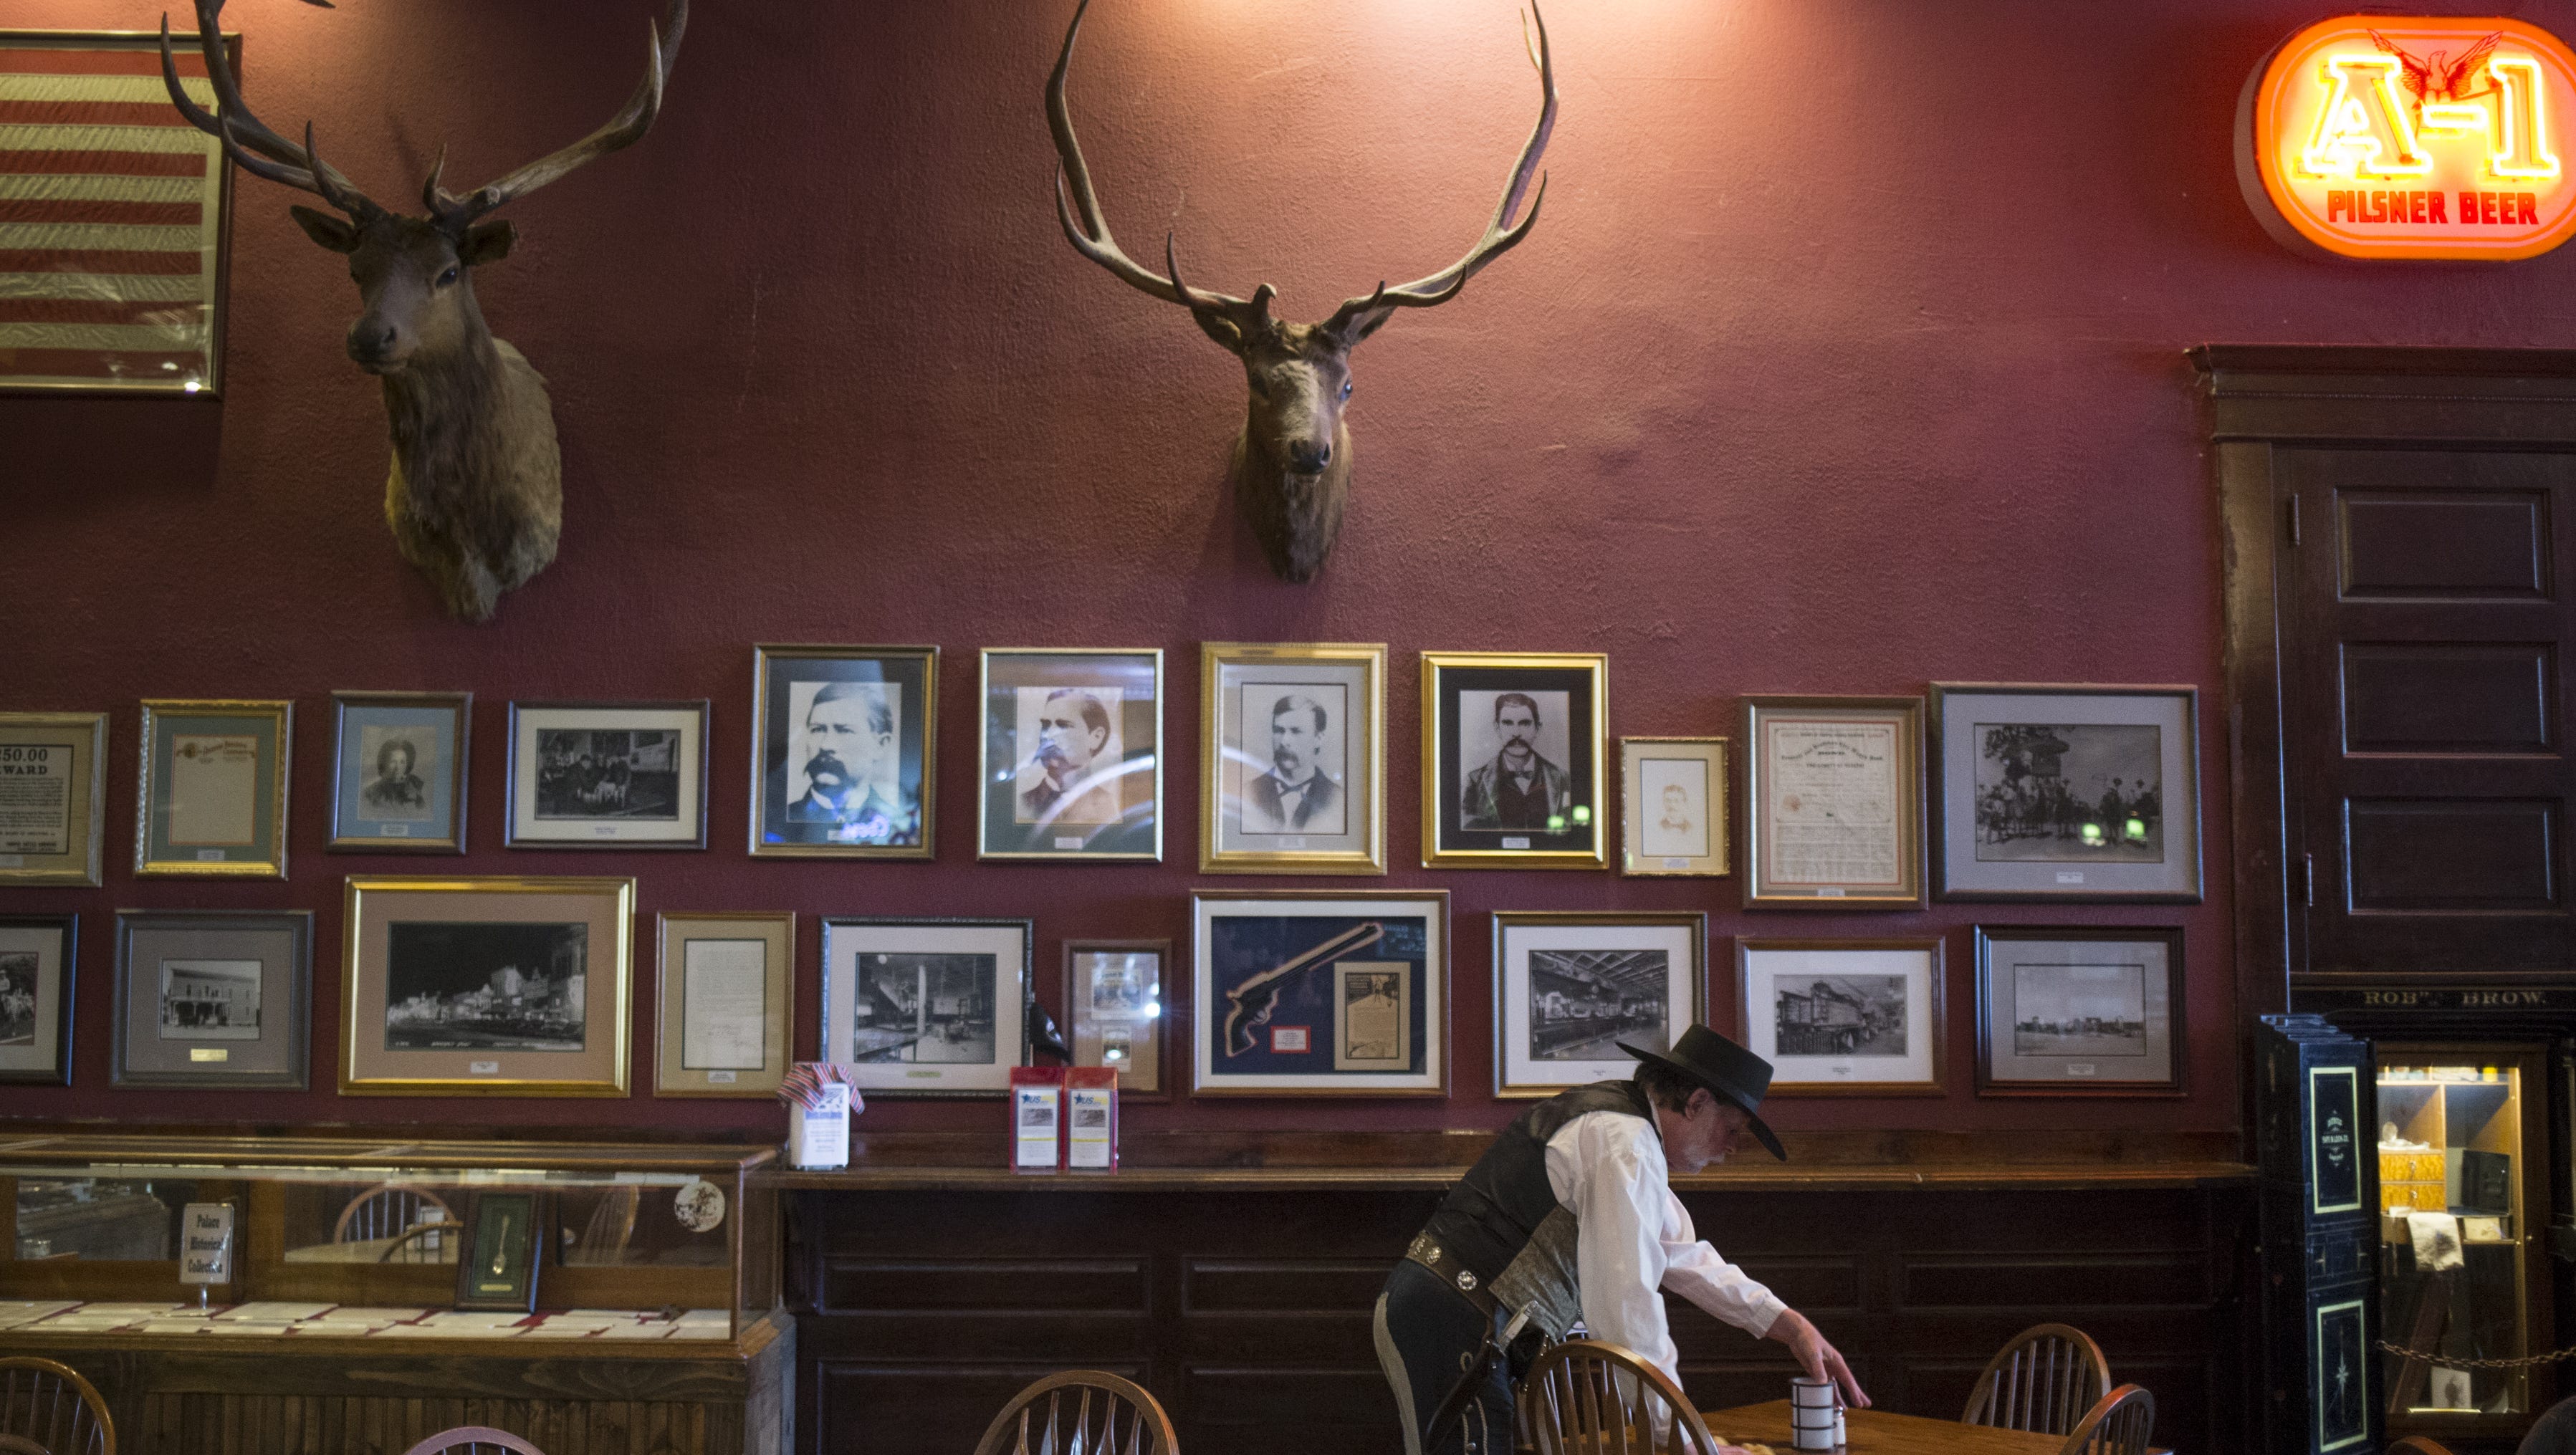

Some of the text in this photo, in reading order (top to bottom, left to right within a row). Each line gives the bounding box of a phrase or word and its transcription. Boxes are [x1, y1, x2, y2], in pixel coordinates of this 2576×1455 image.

[2296, 54, 2560, 179] A-1
[2327, 191, 2539, 225] PILSNER BEER
[0, 748, 48, 762] 50.00
[0, 765, 48, 775] WARD
[197, 1214, 220, 1229] Palace
[190, 1236, 225, 1251] Historical
